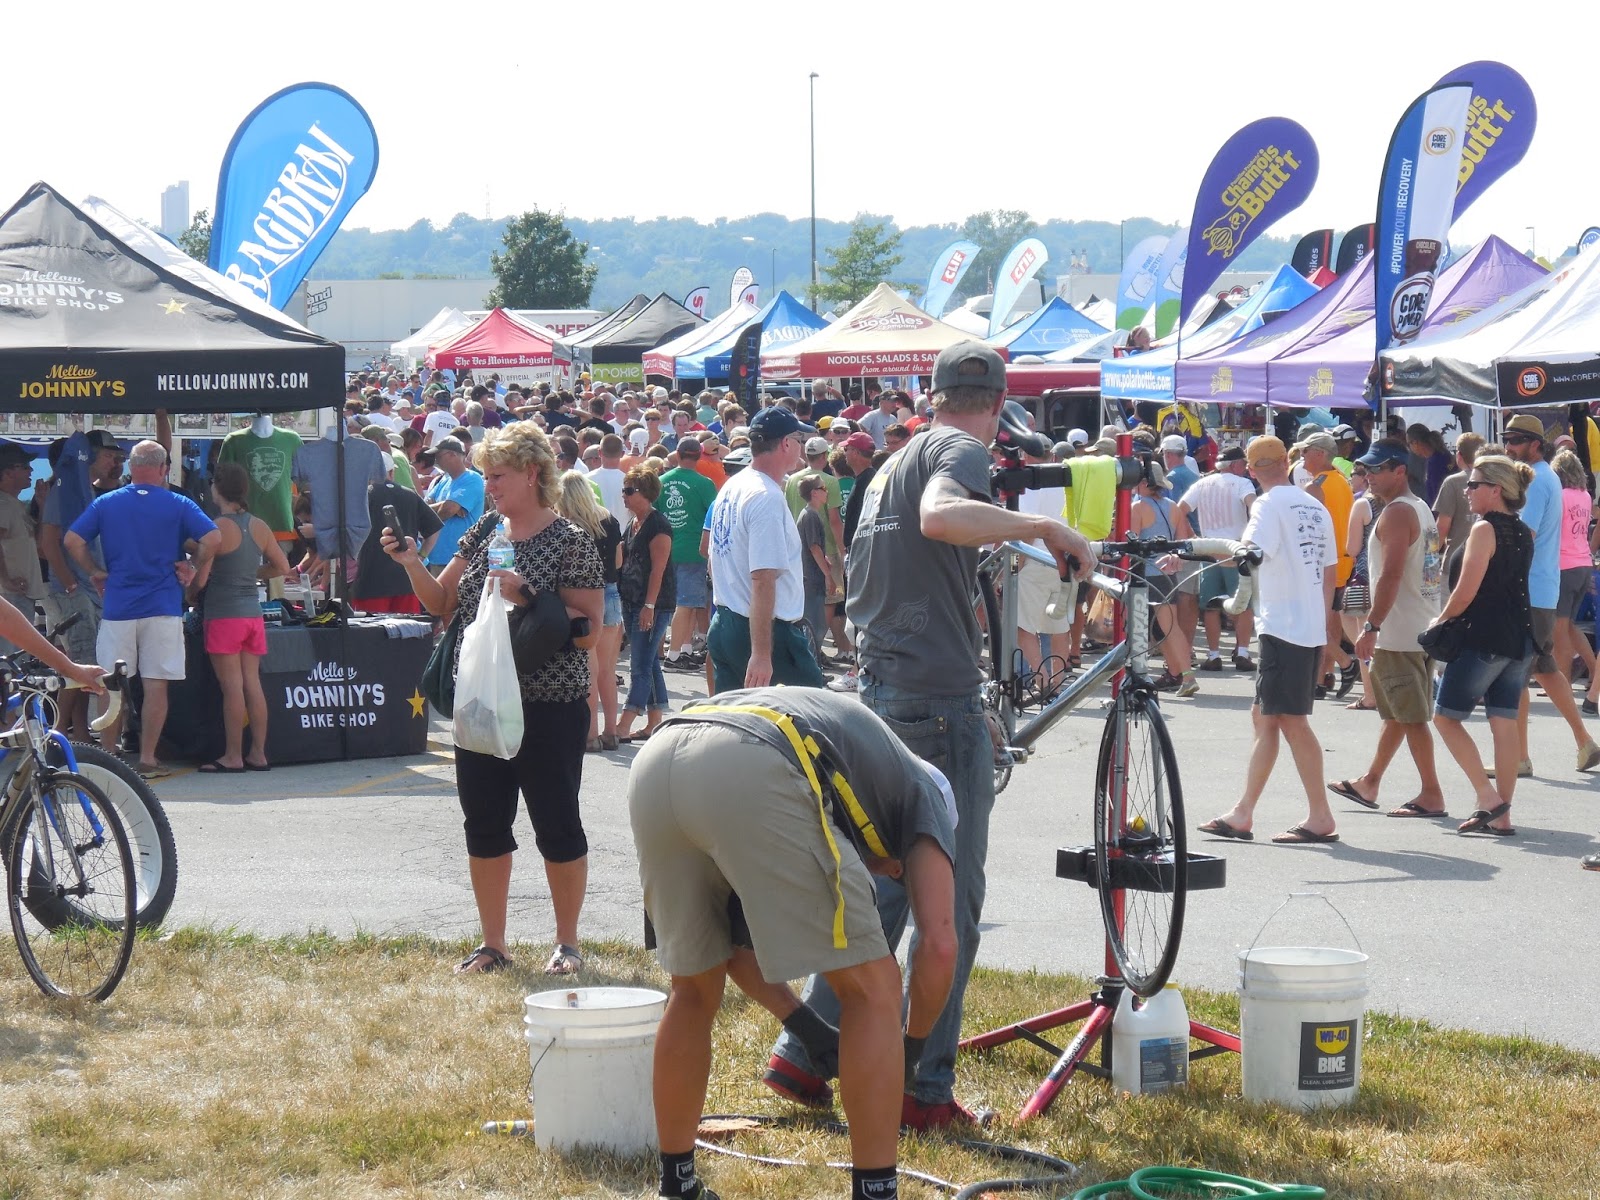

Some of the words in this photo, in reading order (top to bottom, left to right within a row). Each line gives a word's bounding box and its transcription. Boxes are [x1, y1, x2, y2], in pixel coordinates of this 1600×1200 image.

[1432, 134, 1447, 142] CORE
[1222, 145, 1279, 206] Chamois
[1238, 150, 1299, 219] Butt'r
[224, 124, 355, 303] RAGBRAI
[1391, 158, 1413, 274] #POWERYOURRECOVERY
[944, 253, 963, 279] CLIF
[16, 271, 85, 285] Mellow
[0, 283, 124, 304] OHNNY'S
[0, 297, 48, 306] BIKE
[56, 298, 110, 311] SHOP
[859, 314, 923, 328] noodles
[454, 356, 470, 366] The
[472, 356, 487, 365] Des
[488, 355, 518, 365] Moines
[519, 355, 552, 366] Register
[828, 355, 875, 365] NOODLES,
[876, 354, 911, 363] SALADS
[922, 353, 938, 362] SAN
[45, 365, 97, 380] Mellow
[861, 365, 880, 375] from
[882, 364, 910, 373] around
[157, 372, 310, 391] MELLOWJOHNNYS.COM
[1104, 369, 1172, 393] www.polarbottle.com
[1523, 374, 1539, 383] CORE
[20, 380, 126, 398] JOHNNY'S
[854, 529, 872, 538] LUBE
[873, 522, 901, 534] OTECT.
[1132, 593, 1149, 668] GIANT
[301, 714, 334, 728] BIKE
[339, 712, 377, 728] SHOP
[1320, 1030, 1348, 1043] WD-40
[1317, 1056, 1346, 1073] BIKE
[681, 1178, 697, 1192] BIK
[867, 1180, 896, 1192] WD-40
